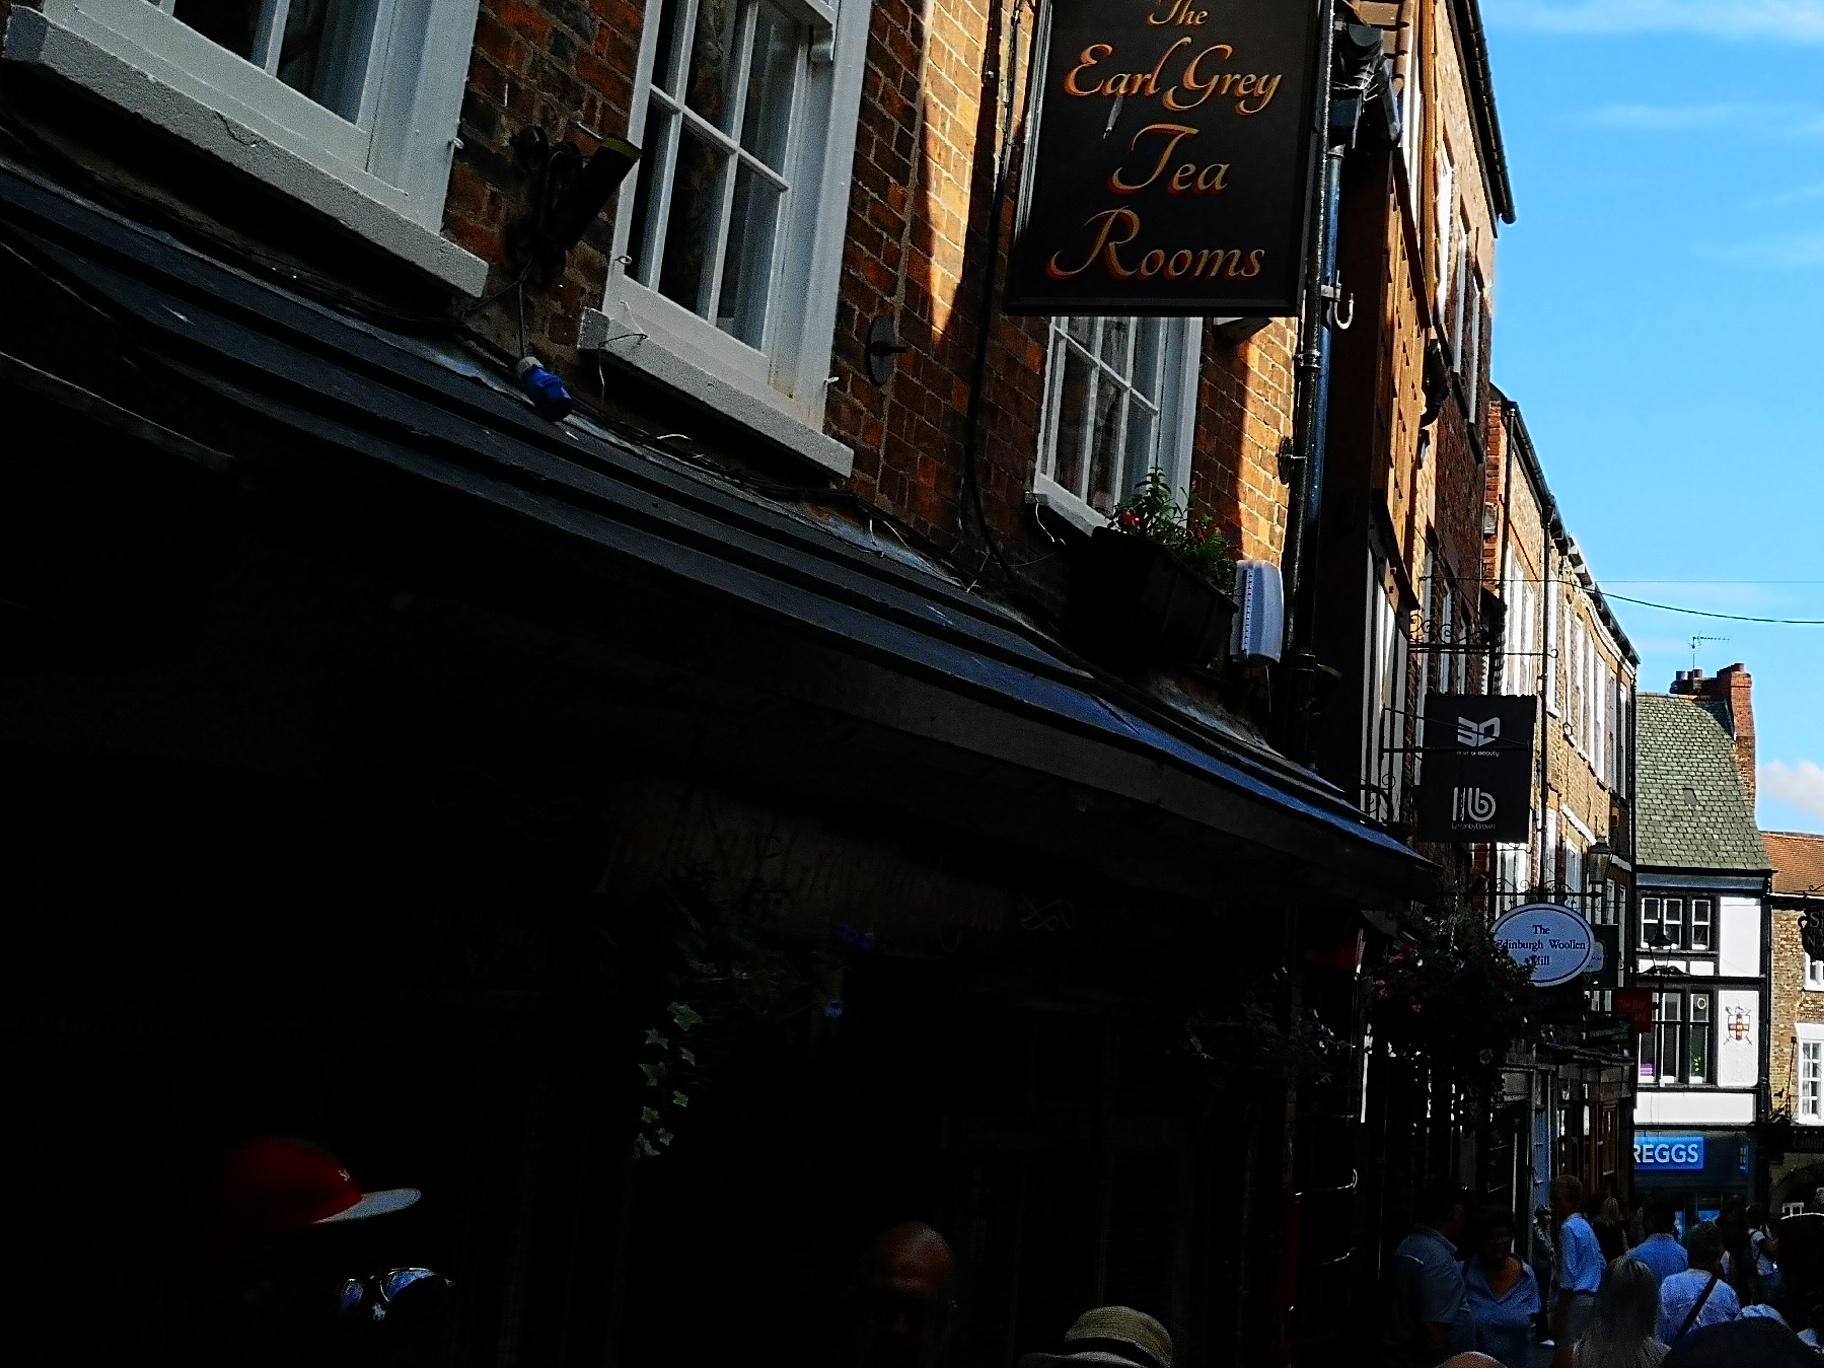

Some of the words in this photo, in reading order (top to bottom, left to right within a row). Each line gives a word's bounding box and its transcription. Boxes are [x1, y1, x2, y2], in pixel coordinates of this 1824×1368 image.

[1064, 36, 1192, 98] Earl
[1162, 43, 1283, 116] Grey
[1107, 123, 1232, 195] Tea
[1046, 205, 1266, 281] Rooms
[1532, 924, 1550, 935] The
[1549, 938, 1586, 950] Woollen
[1633, 1143, 1700, 1165] REGGS
